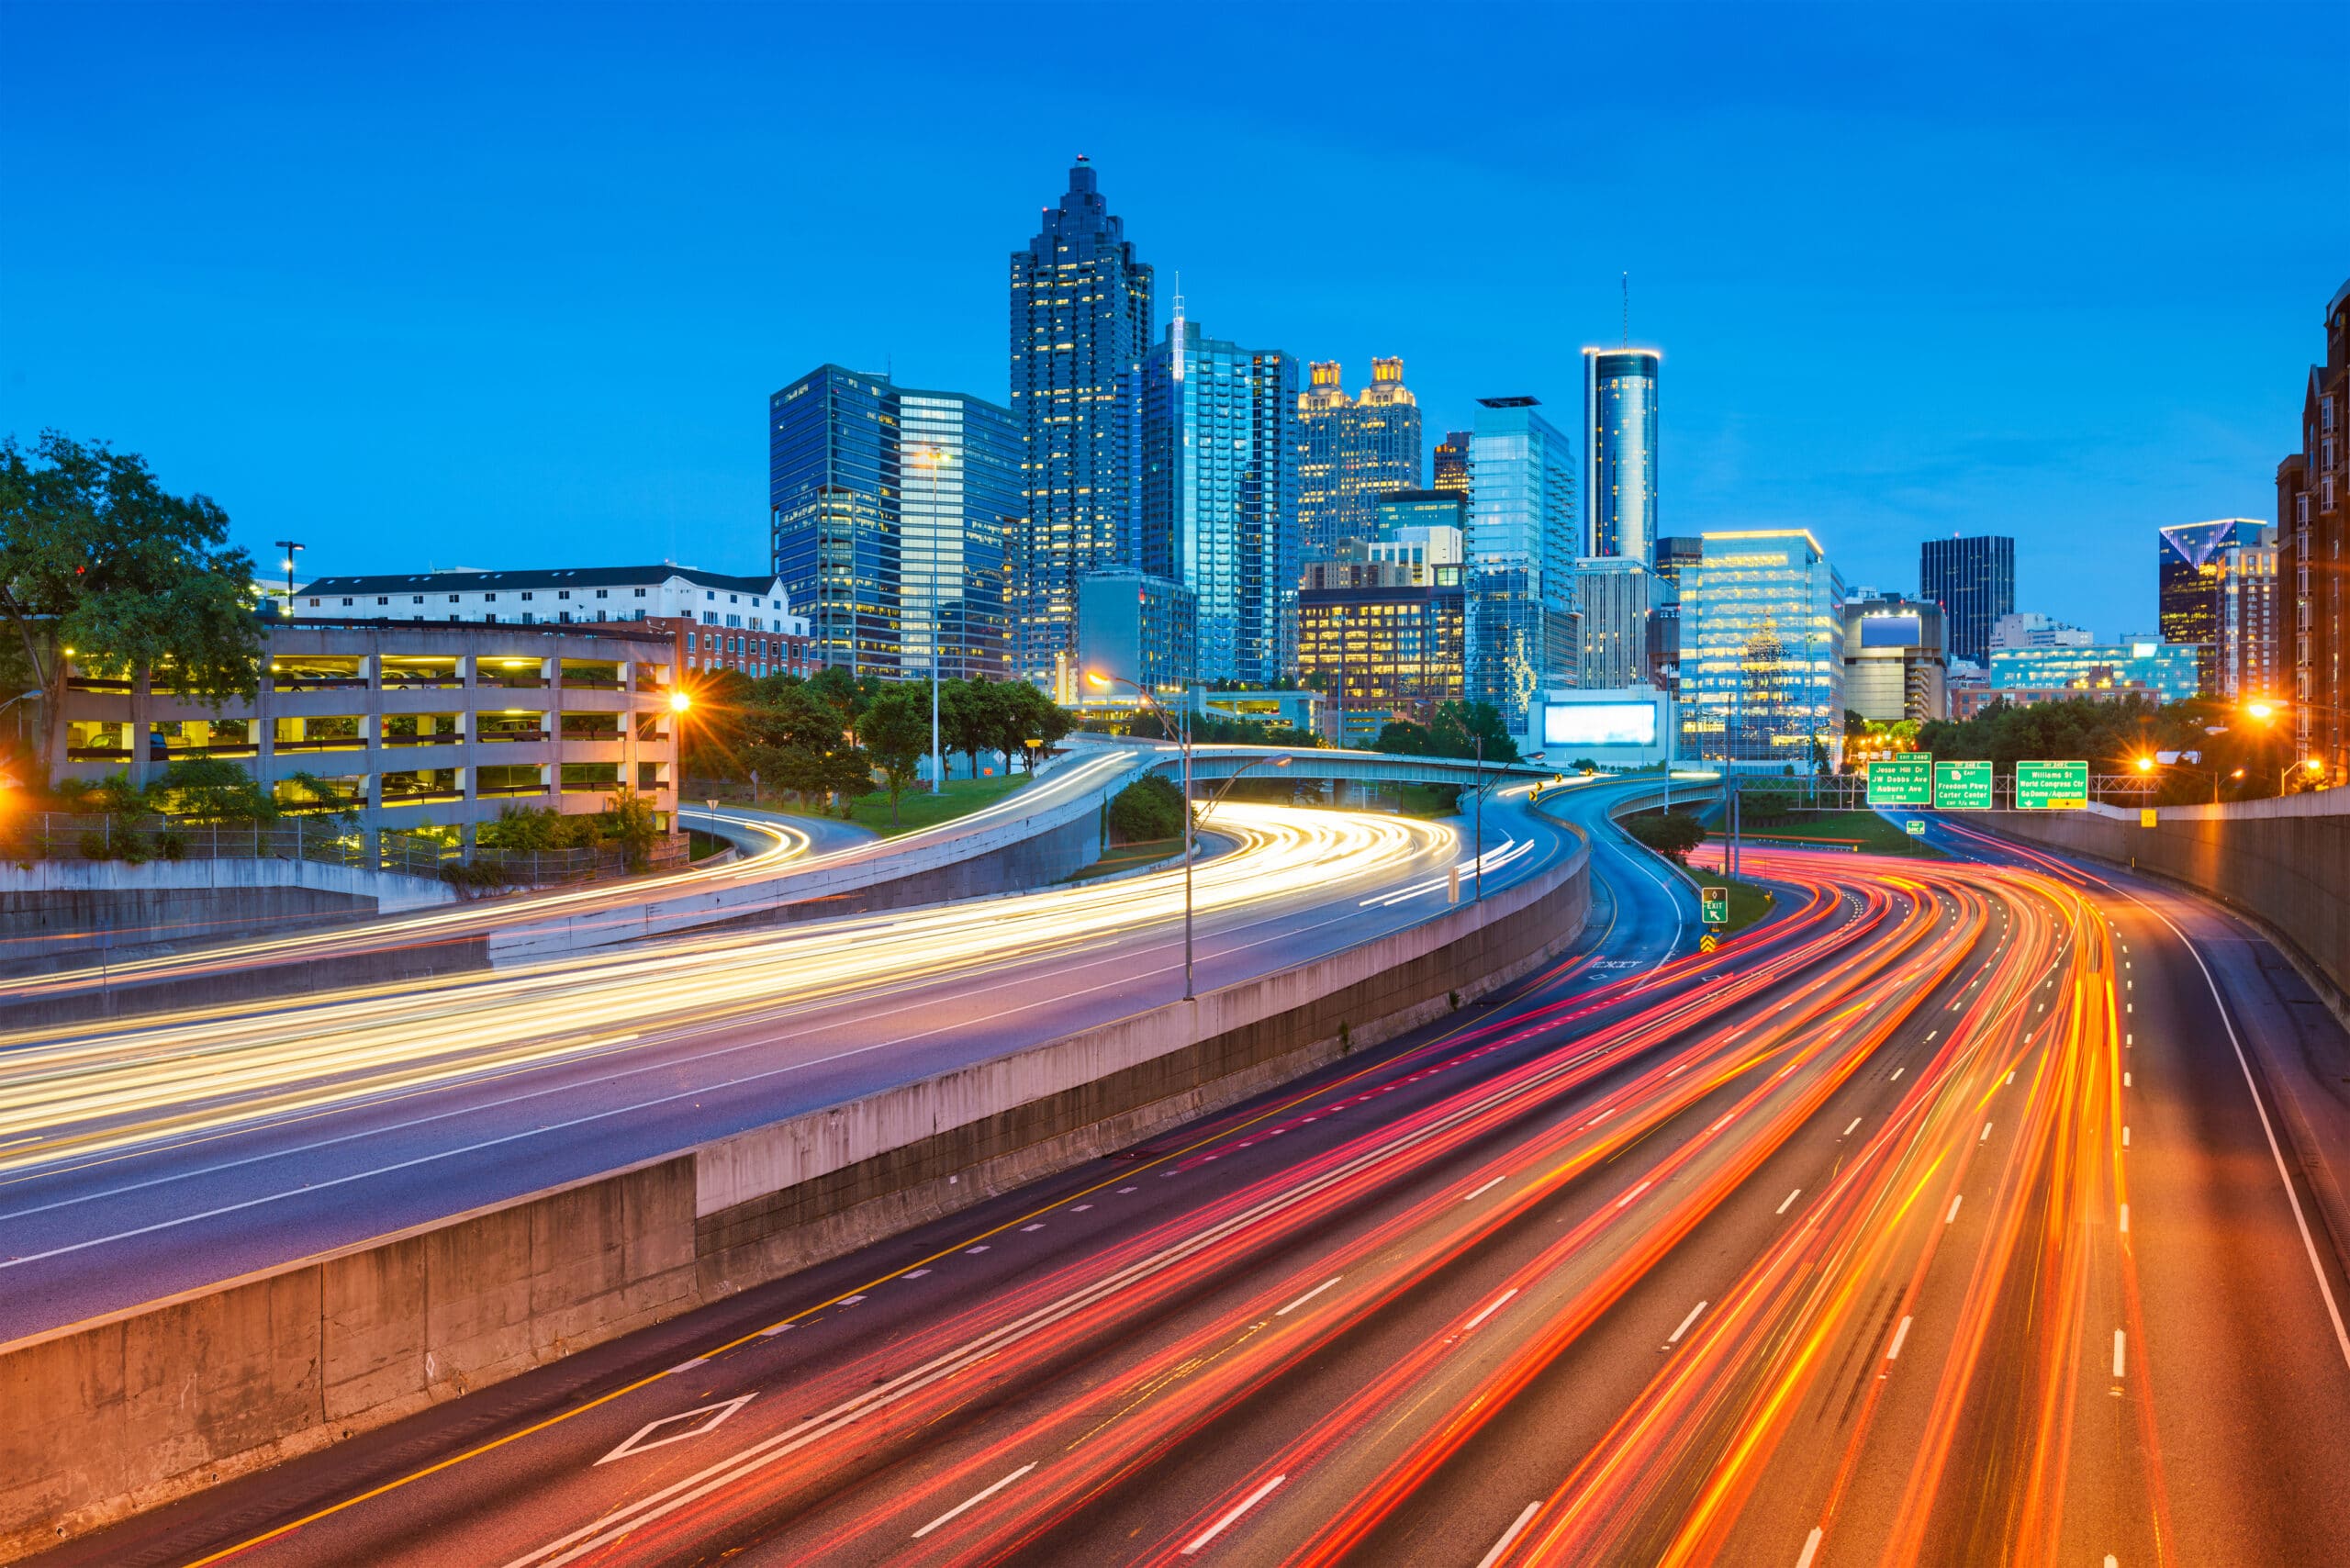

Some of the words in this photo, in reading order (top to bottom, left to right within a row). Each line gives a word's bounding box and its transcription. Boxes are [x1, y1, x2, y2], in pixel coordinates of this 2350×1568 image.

[1969, 782, 1988, 791] Pkwy
[2040, 780, 2071, 789] Congress
[1592, 960, 1643, 969] EXIT
